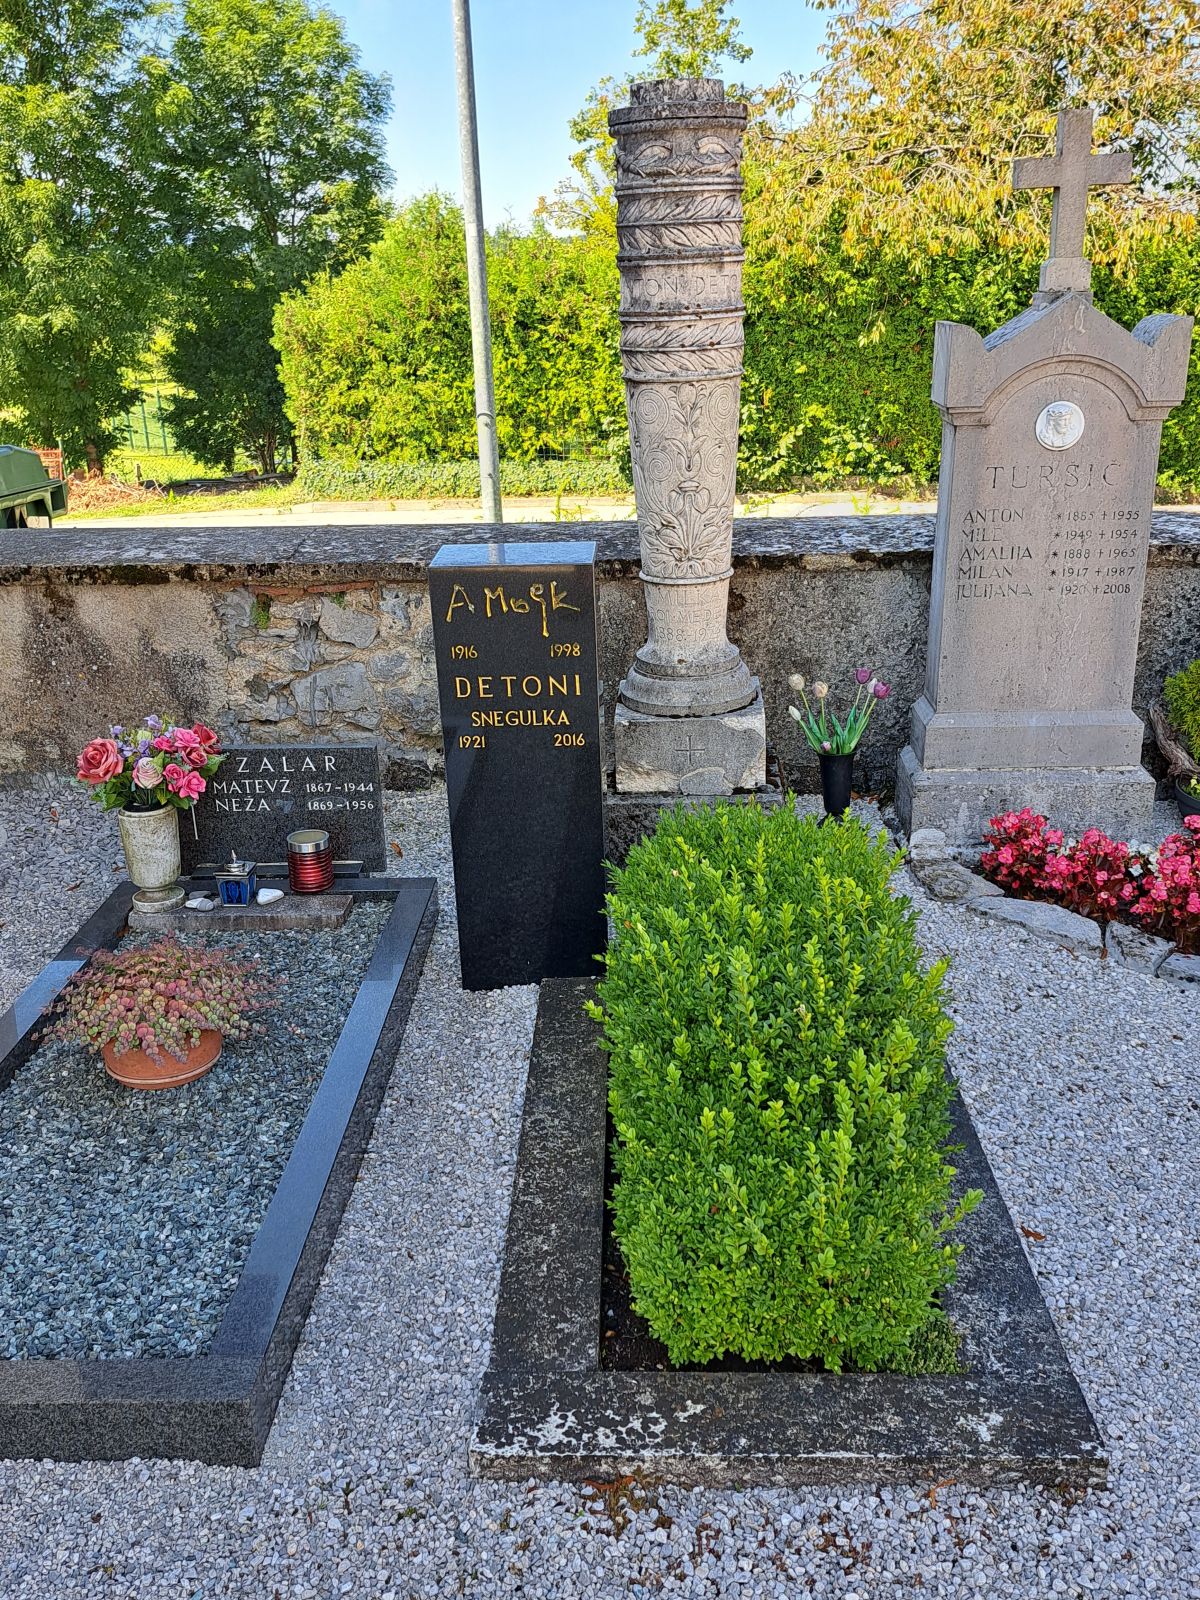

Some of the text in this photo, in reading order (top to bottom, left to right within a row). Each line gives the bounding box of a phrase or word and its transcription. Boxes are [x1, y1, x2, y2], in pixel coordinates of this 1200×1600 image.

[962, 508, 1025, 524] ANTON
[1112, 510, 1140, 521] 1955
[1110, 529, 1138, 540] 1954
[960, 546, 1033, 561] AMALIJA
[1064, 548, 1090, 560] 1888
[957, 565, 1135, 580] MILAN 1917 1987
[955, 583, 1033, 600] JULIJANA
[1103, 583, 1131, 595] 2008
[451, 643, 581, 660] 1916 1998
[455, 675, 581, 698] DETONI
[471, 710, 570, 727] SNEGULKA
[459, 733, 585, 748] 1921 2016
[236, 756, 337, 773] ZALAR
[213, 777, 291, 794] MATEVŽ
[215, 796, 271, 812] NEŽA
